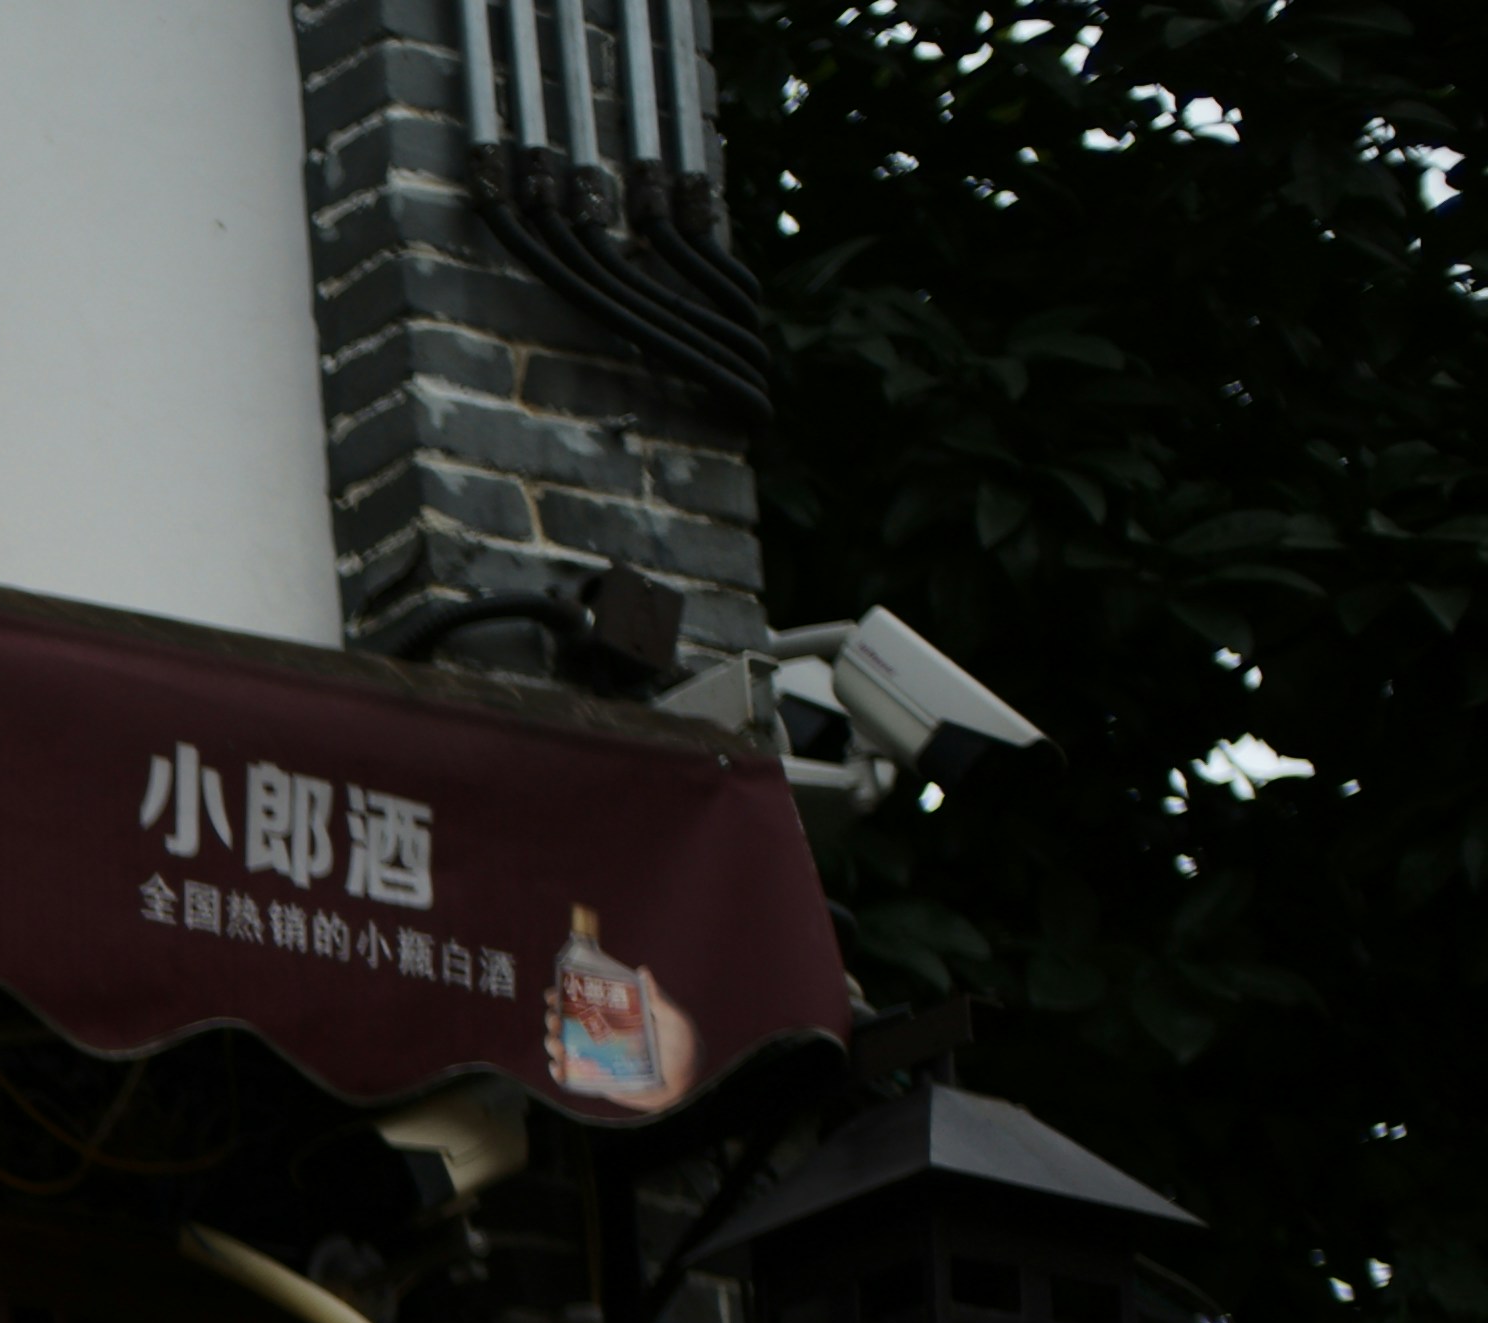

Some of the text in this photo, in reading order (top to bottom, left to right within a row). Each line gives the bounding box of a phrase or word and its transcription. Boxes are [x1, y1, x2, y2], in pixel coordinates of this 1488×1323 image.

[139, 740, 435, 911] 小郎酒
[139, 872, 518, 1001] 全国热销的小瓶白酒
